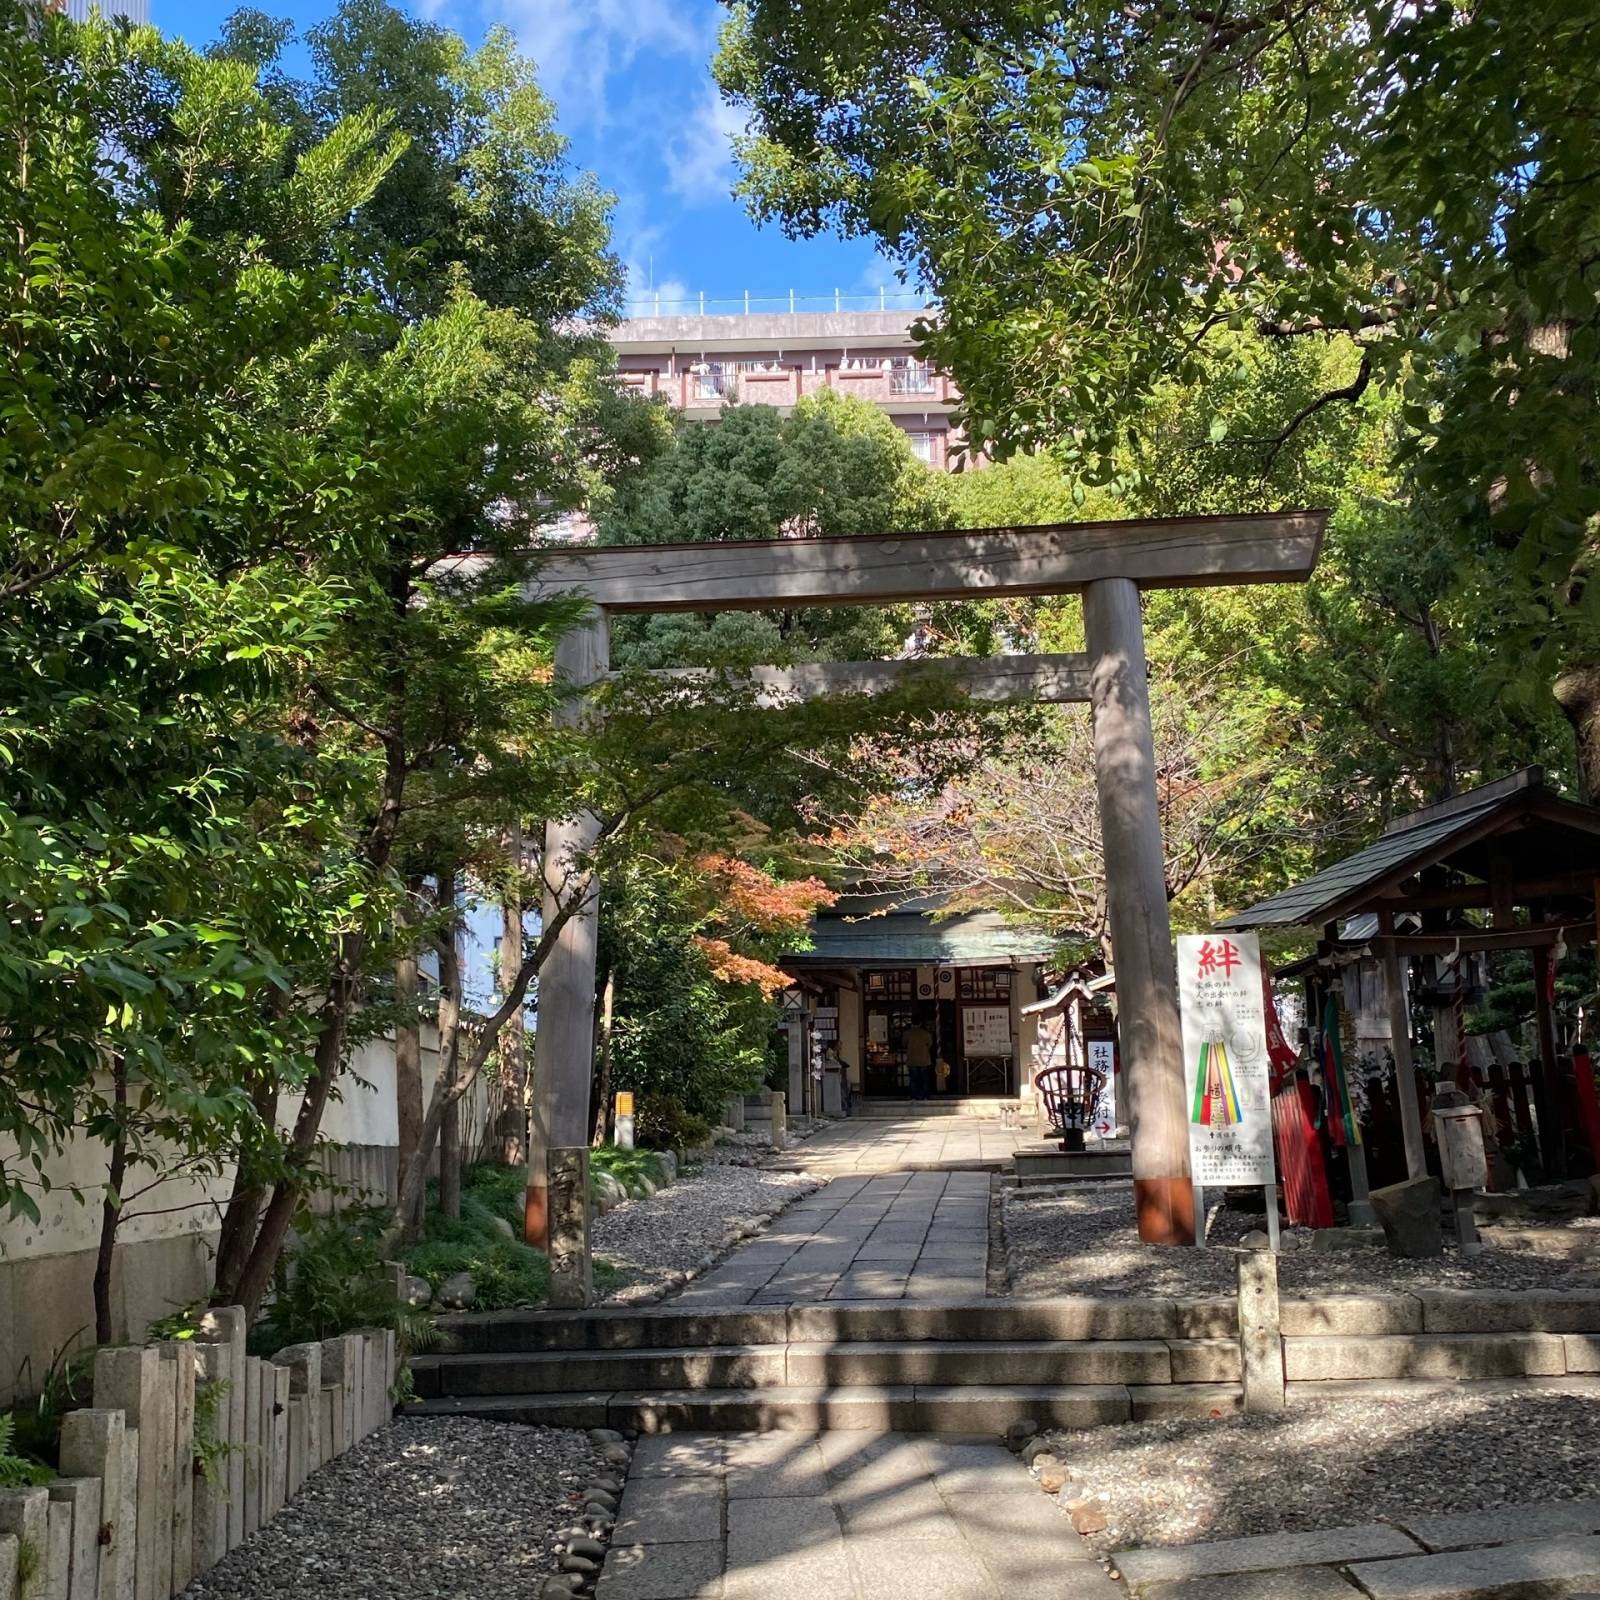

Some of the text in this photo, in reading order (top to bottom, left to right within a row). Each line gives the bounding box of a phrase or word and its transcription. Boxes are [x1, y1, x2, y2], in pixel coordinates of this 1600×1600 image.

[1197, 939, 1243, 979] 絆
[1093, 1046, 1111, 1119] 社務受付
